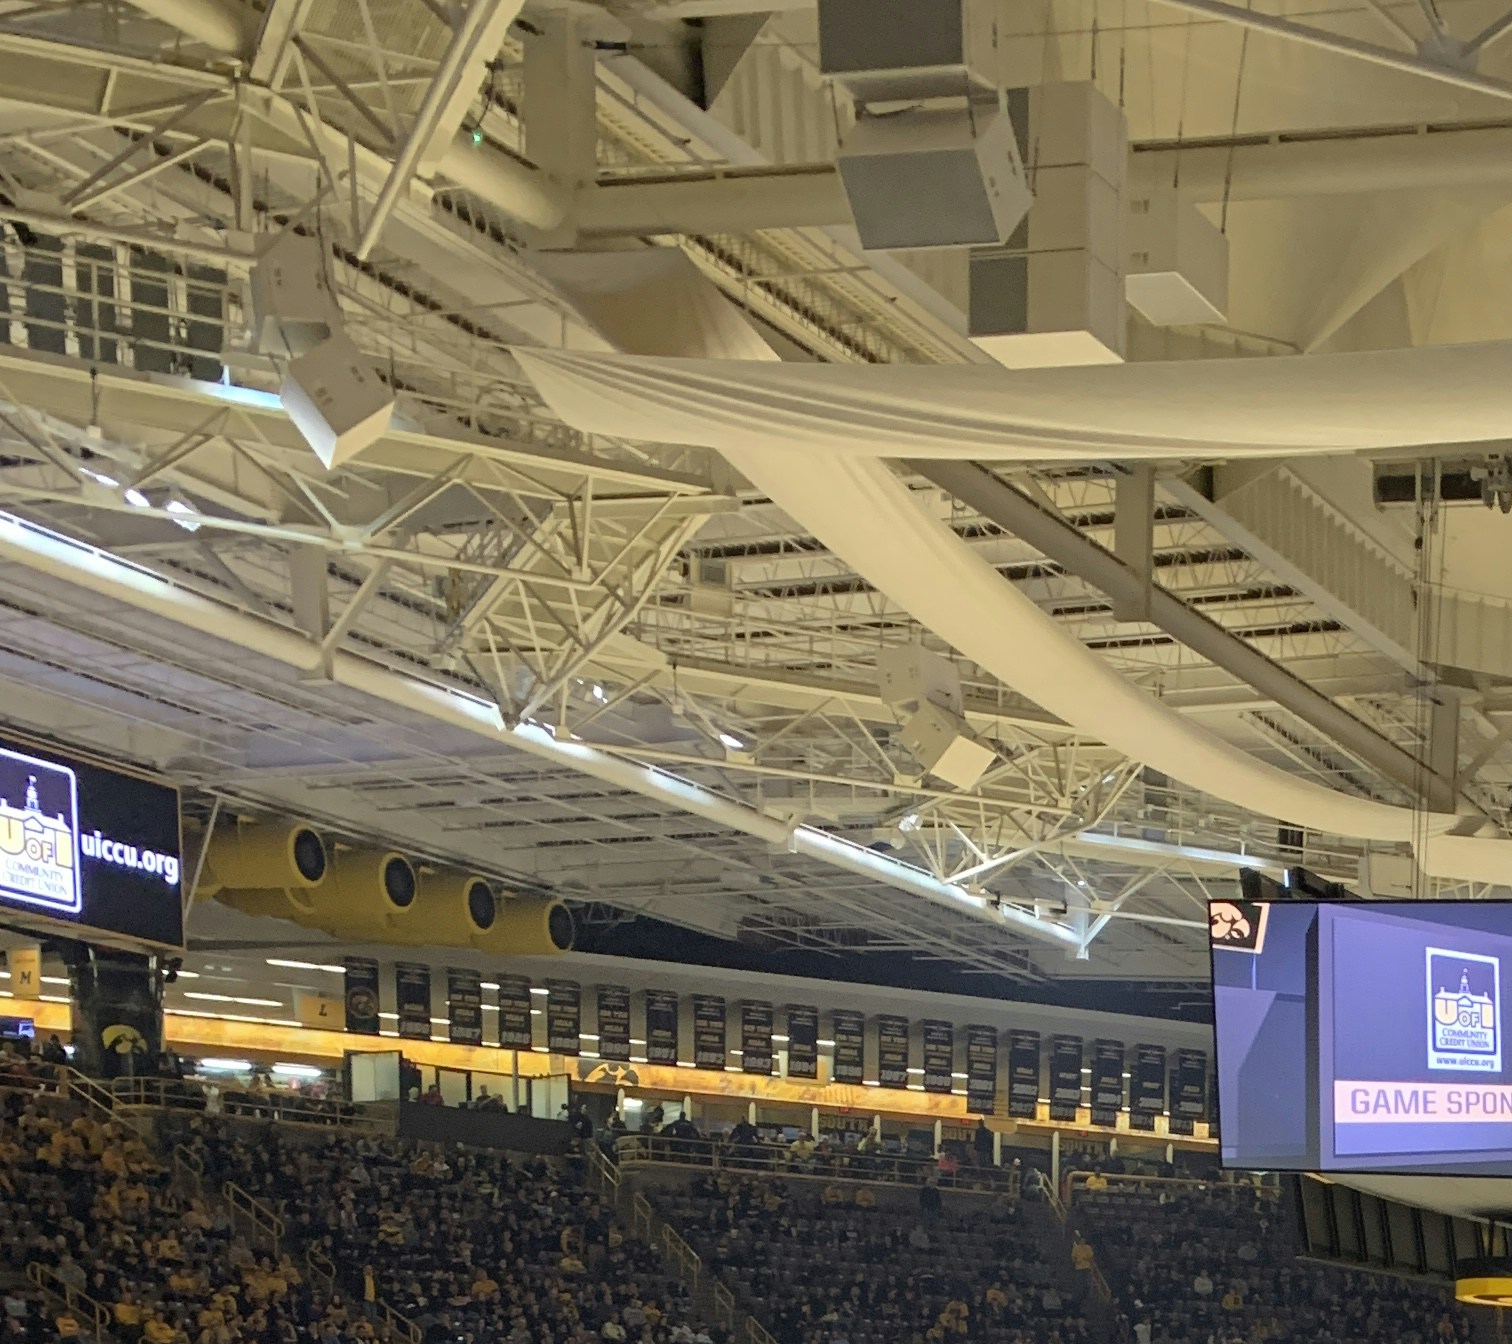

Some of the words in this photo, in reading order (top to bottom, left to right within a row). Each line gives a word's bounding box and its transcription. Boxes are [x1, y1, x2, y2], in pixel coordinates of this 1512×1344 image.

[81, 830, 178, 884] uiccu.org
[1459, 1011, 1480, 1028] OF
[1442, 1027, 1488, 1039] COMMUNITY
[1440, 1037, 1465, 1047] CREDIT
[1467, 1039, 1490, 1048] UNION
[1436, 1056, 1495, 1069] www.uiccu.org
[1351, 1088, 1437, 1115] GAME
